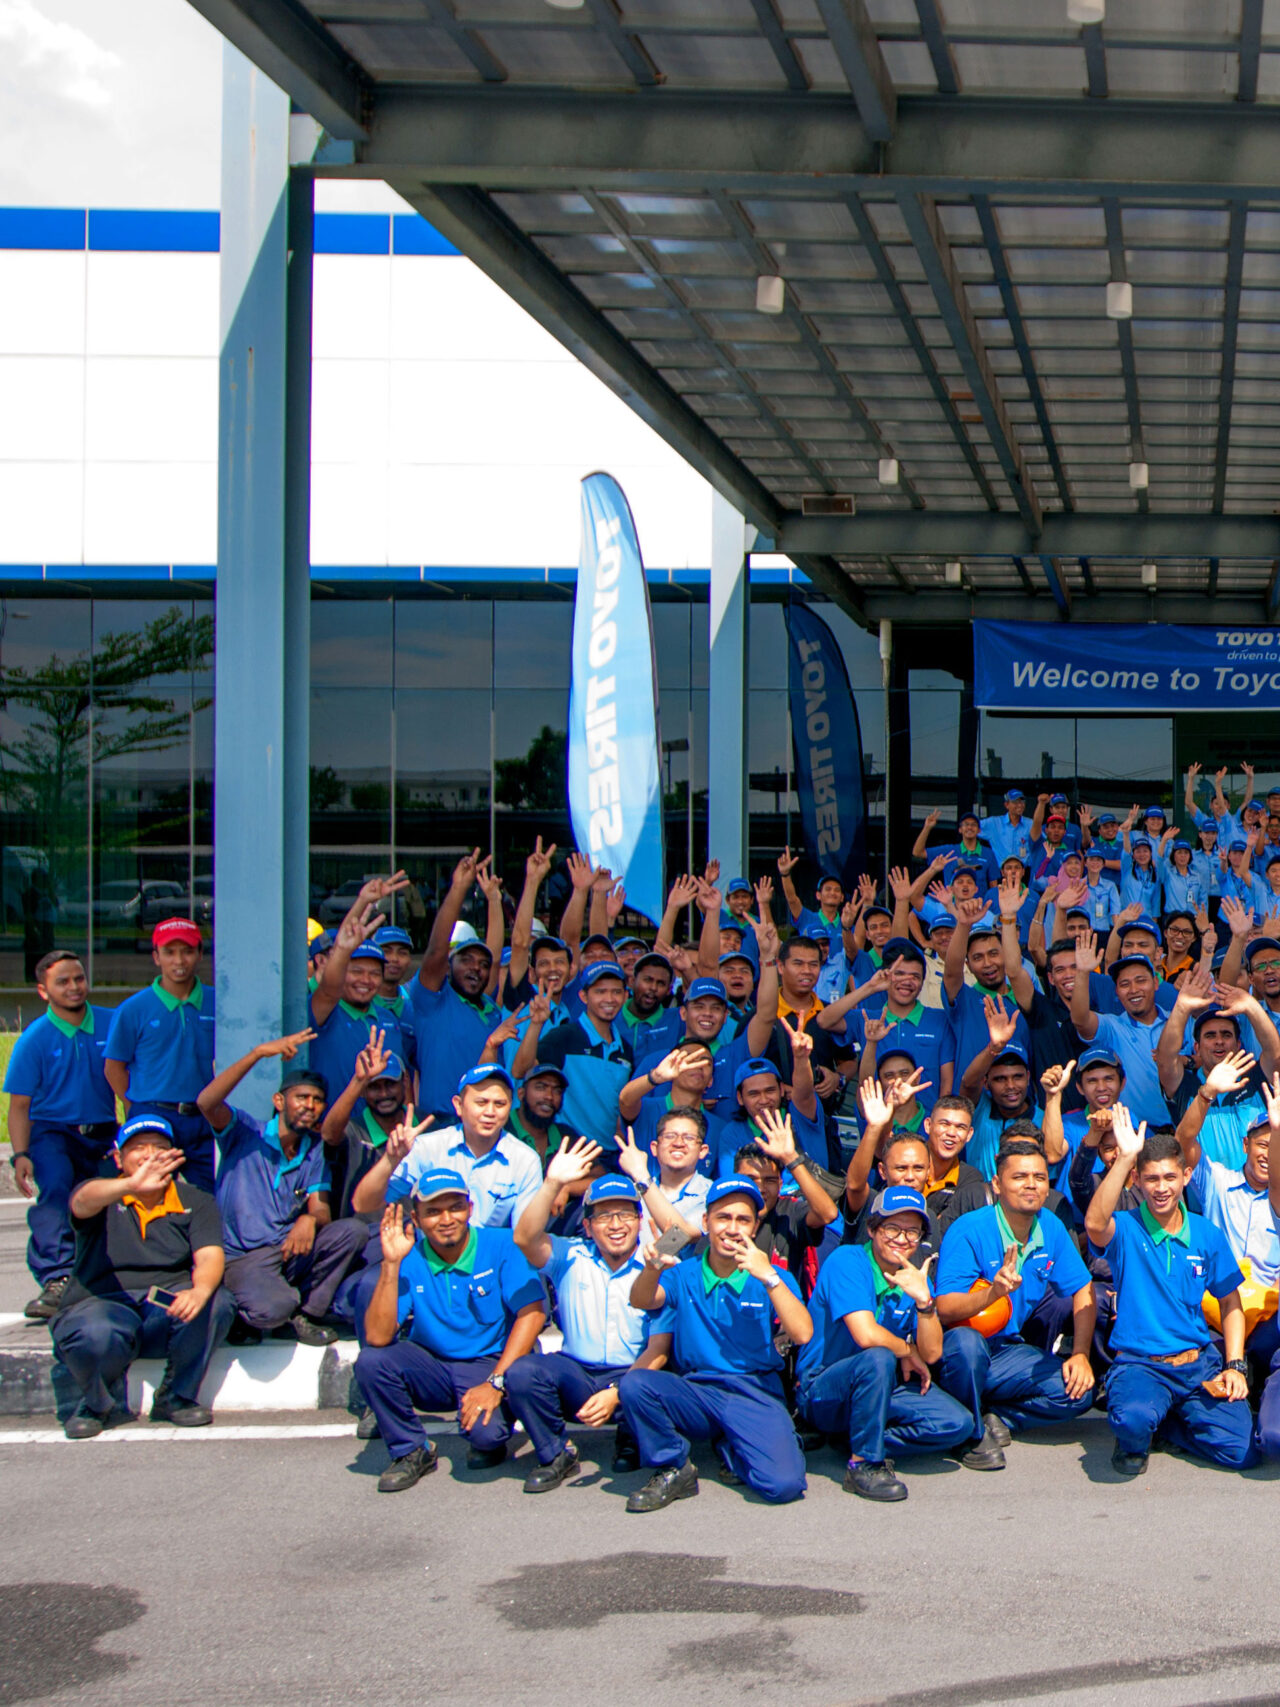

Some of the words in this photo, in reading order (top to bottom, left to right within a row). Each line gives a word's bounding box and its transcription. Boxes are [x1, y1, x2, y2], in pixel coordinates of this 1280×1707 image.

[1216, 632, 1274, 646] TOYO
[1227, 649, 1263, 661] driven
[1265, 651, 1277, 661] to
[1012, 661, 1159, 688] Welcome
[1169, 667, 1200, 690] to
